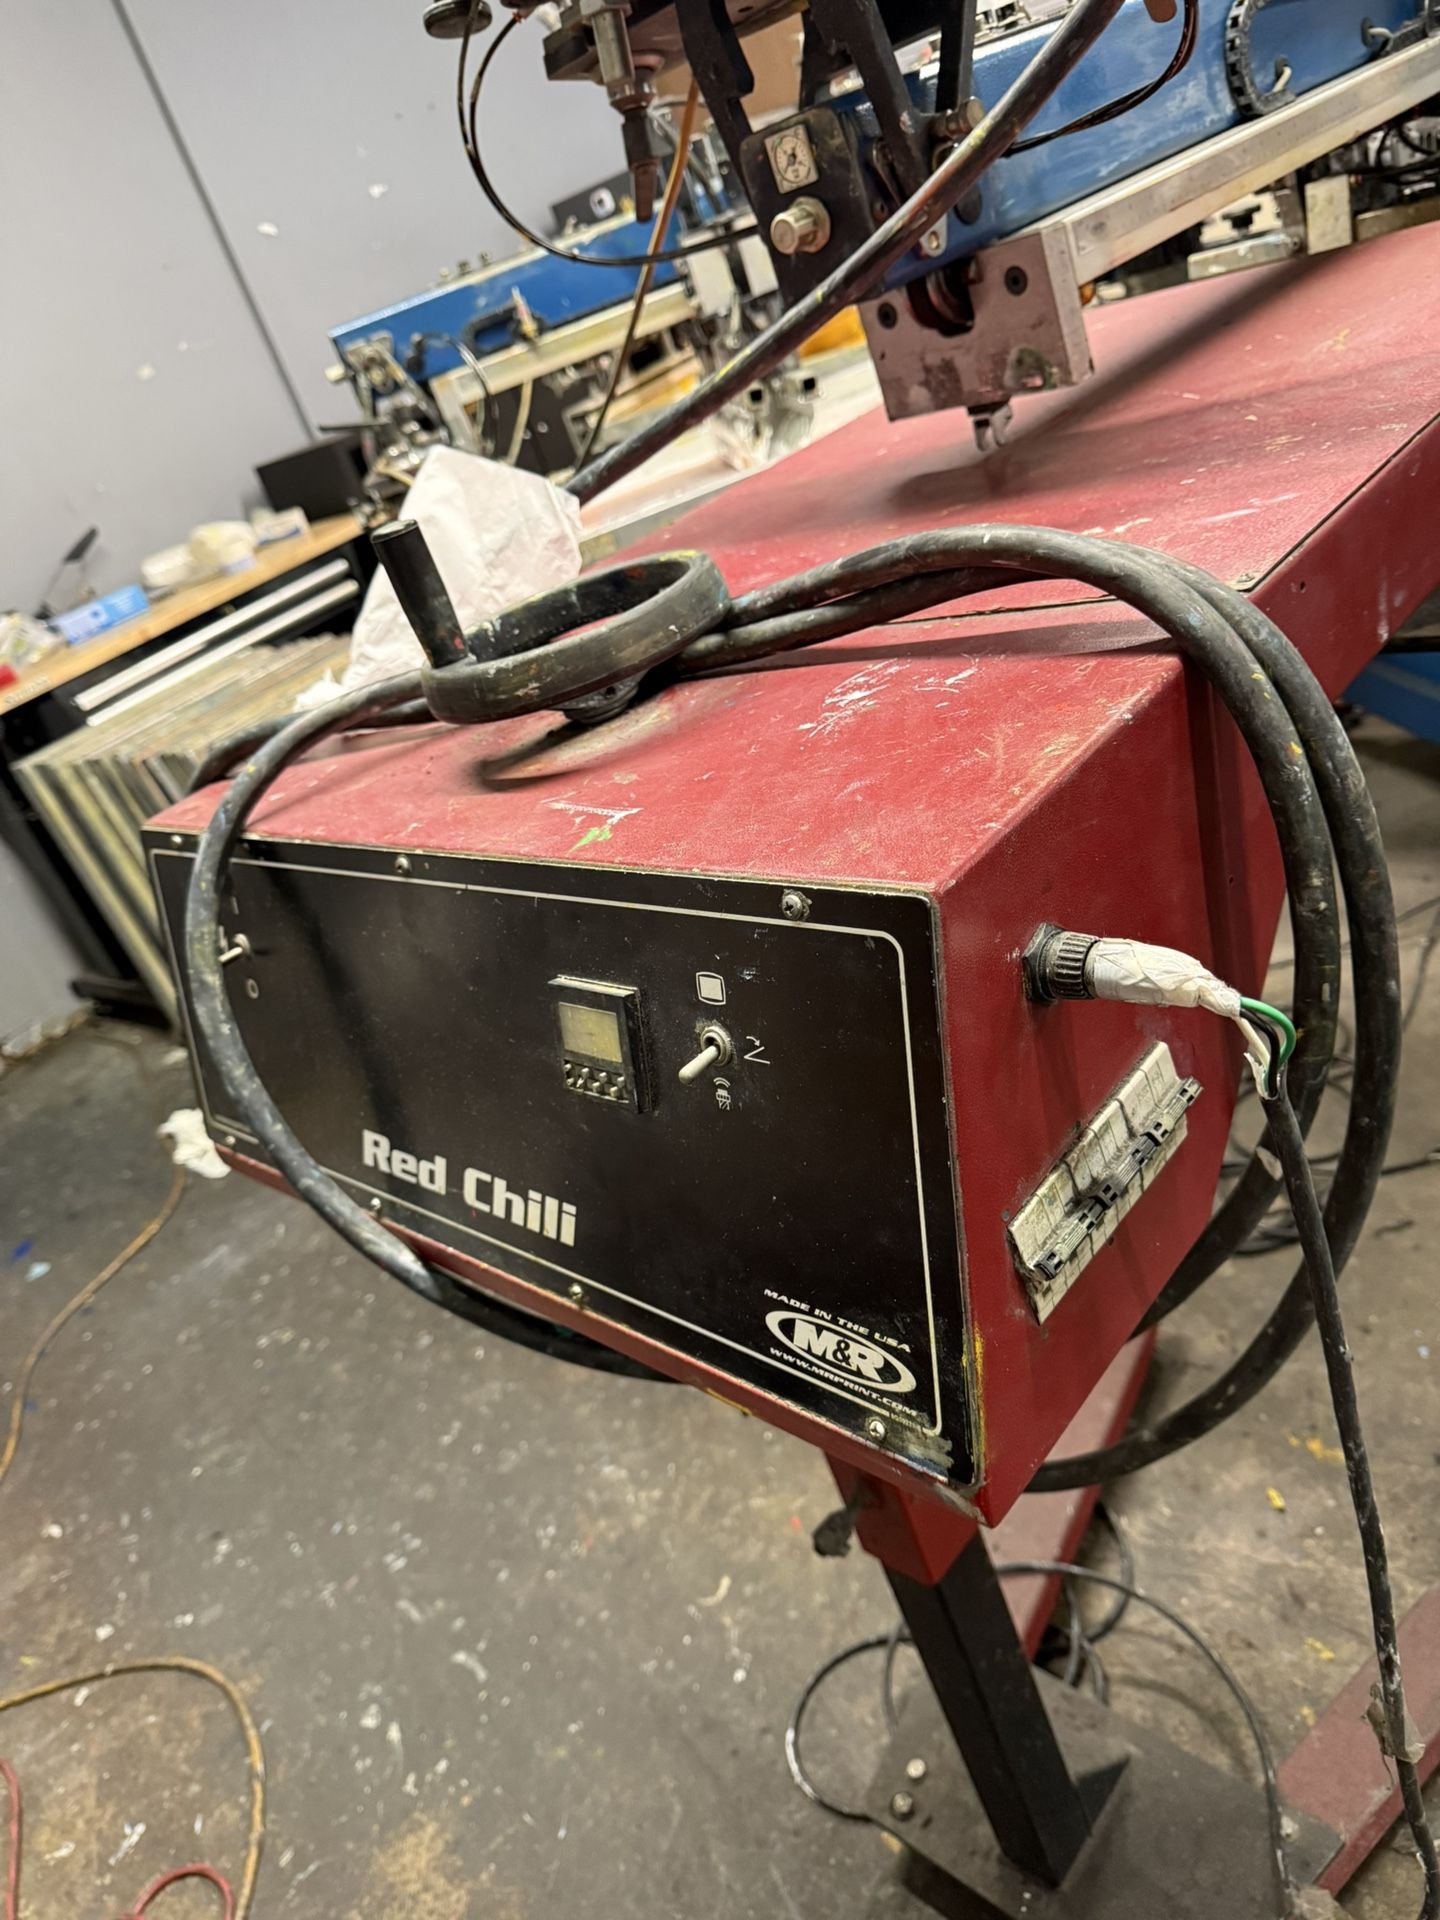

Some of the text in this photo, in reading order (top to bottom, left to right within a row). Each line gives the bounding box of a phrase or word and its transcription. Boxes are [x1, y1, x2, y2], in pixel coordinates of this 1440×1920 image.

[362, 1129, 577, 1247] Red Chili
[763, 1288, 911, 1353] MADE IN THE USA
[793, 1318, 885, 1383] M&R
